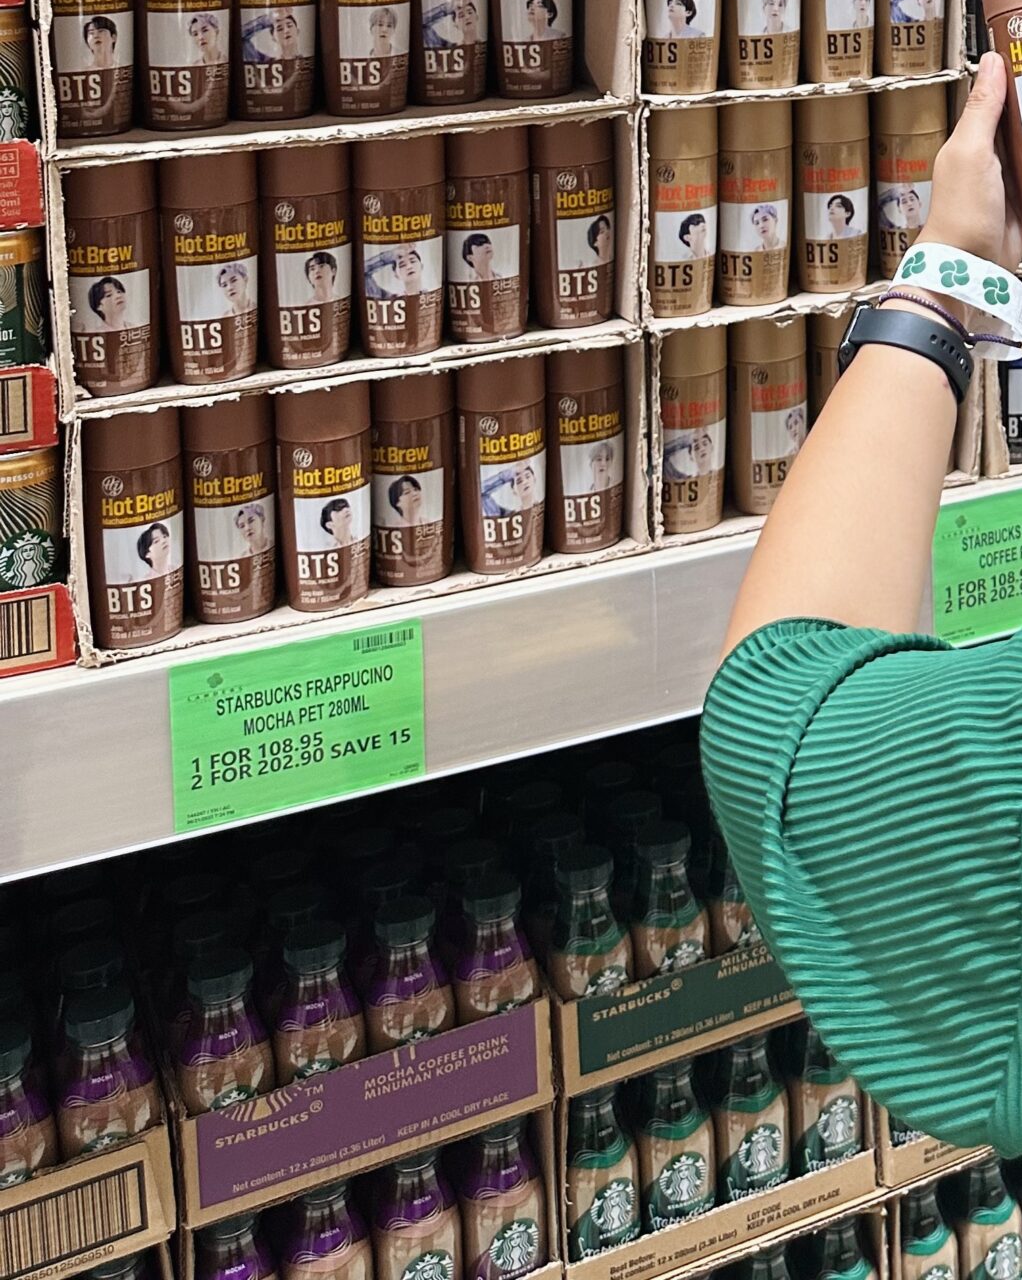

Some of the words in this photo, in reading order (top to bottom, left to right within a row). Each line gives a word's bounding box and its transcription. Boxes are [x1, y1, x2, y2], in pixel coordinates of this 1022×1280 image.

[891, 25, 925, 46] BTS
[174, 234, 202, 254] Hot
[206, 232, 247, 251] Brew
[181, 322, 222, 350] BTS
[102, 496, 133, 517] Hot
[136, 487, 174, 512] Brew
[962, 525, 1021, 551] STARBUCKS
[979, 547, 1017, 568] COFFEE
[107, 584, 152, 613] BTS
[945, 586, 952, 598] 1
[958, 579, 986, 596] FOR
[945, 601, 953, 613] 2
[958, 594, 986, 610] FOR
[216, 684, 302, 716] STARBUCKS
[306, 664, 393, 698] FRAPPUCINO
[244, 710, 295, 736] MOCHA
[300, 704, 324, 724] PET
[329, 695, 370, 718] 280ML
[191, 758, 200, 773] 1
[210, 748, 251, 769] FOR
[258, 731, 324, 759] 108.95
[191, 775, 202, 790] 2
[211, 763, 252, 785] FOR
[258, 748, 324, 776] 202.90
[331, 734, 382, 759] SAVE
[389, 728, 411, 746] 15
[721, 952, 749, 968] MILK
[592, 988, 671, 1022] STARBUCKS
[364, 1066, 415, 1090] MOCHA
[418, 1049, 464, 1071] COFFEE
[468, 1034, 509, 1055] DRINK
[364, 1071, 432, 1100] MINUMAN
[436, 1059, 467, 1076] KOPI
[471, 1045, 509, 1064] MOKA
[215, 1111, 309, 1148] STARBUCKS
[397, 1122, 419, 1137] KEEP
[421, 1119, 430, 1129] IN
[432, 1117, 439, 1125] A
[440, 1110, 462, 1123] COOL
[464, 1102, 481, 1114] DRY
[483, 1092, 510, 1107] PLACE
[232, 1182, 249, 1193] Net
[289, 1163, 300, 1173] 12
